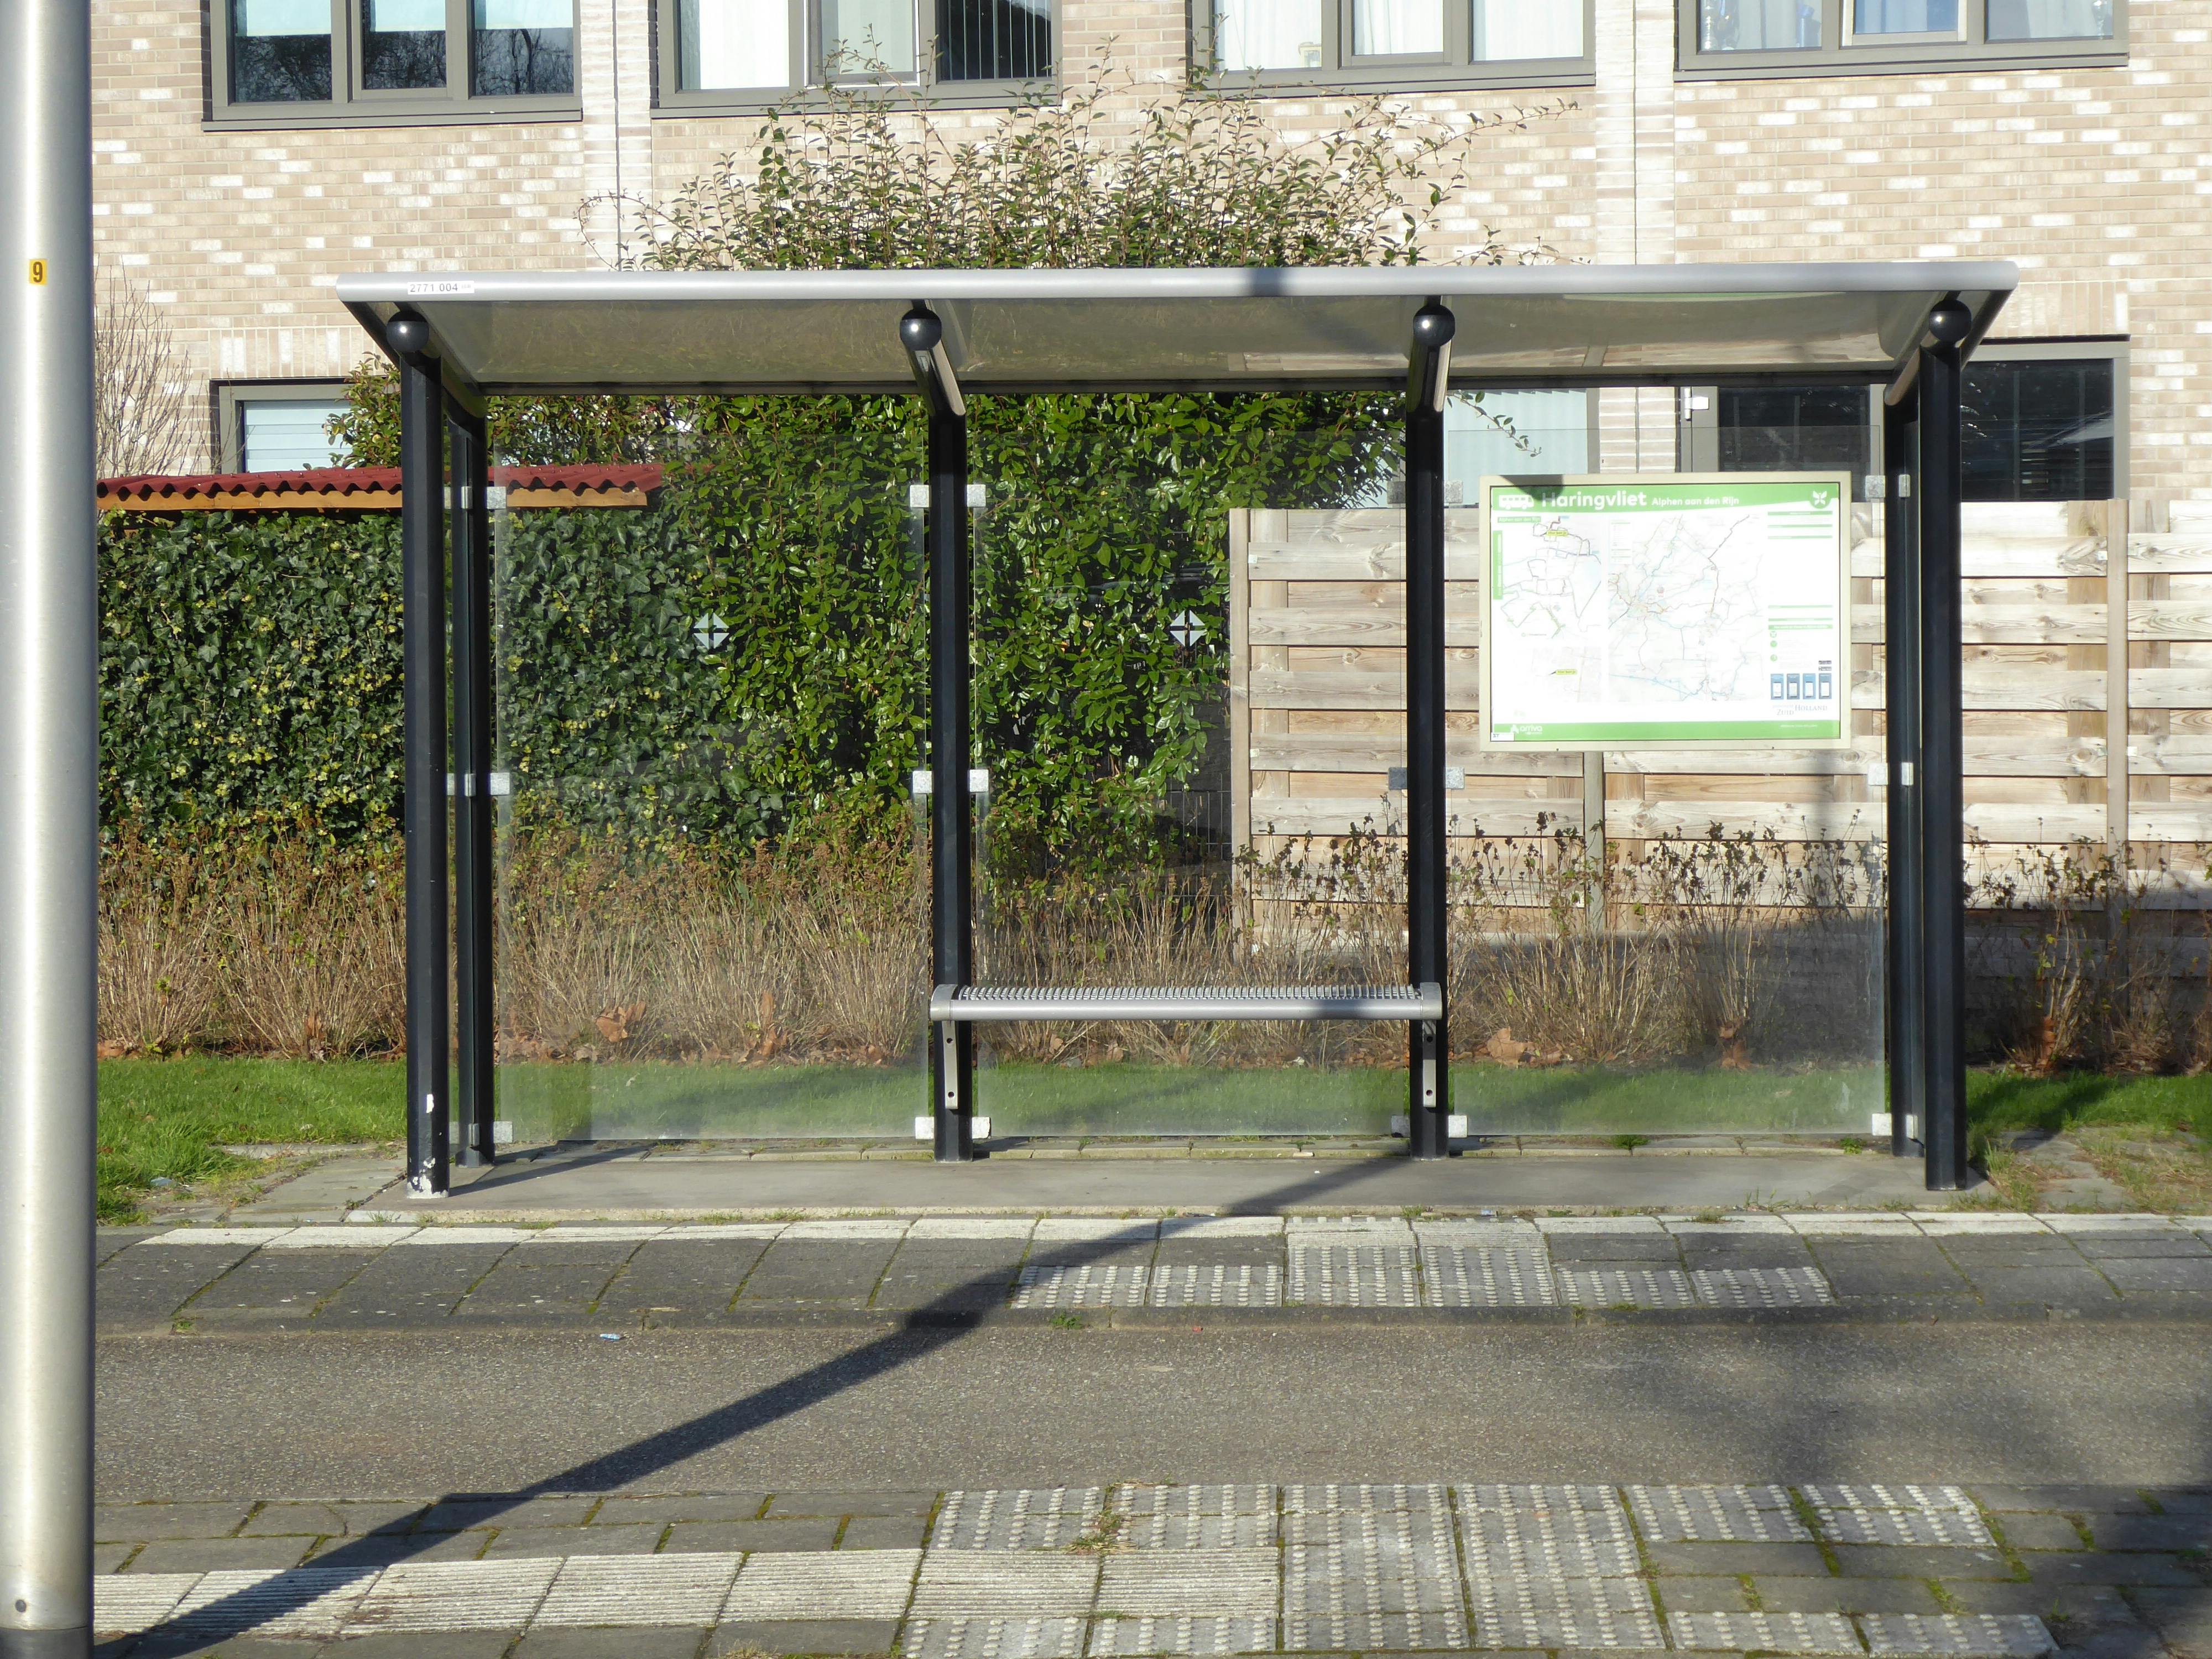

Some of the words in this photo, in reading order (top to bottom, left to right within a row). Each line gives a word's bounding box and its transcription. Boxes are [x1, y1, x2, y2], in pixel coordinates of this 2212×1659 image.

[33, 261, 43, 283] 9
[1542, 491, 1647, 510] Haringvliet
[1651, 497, 1683, 507] Alphen
[1723, 496, 1739, 506] Rijn
